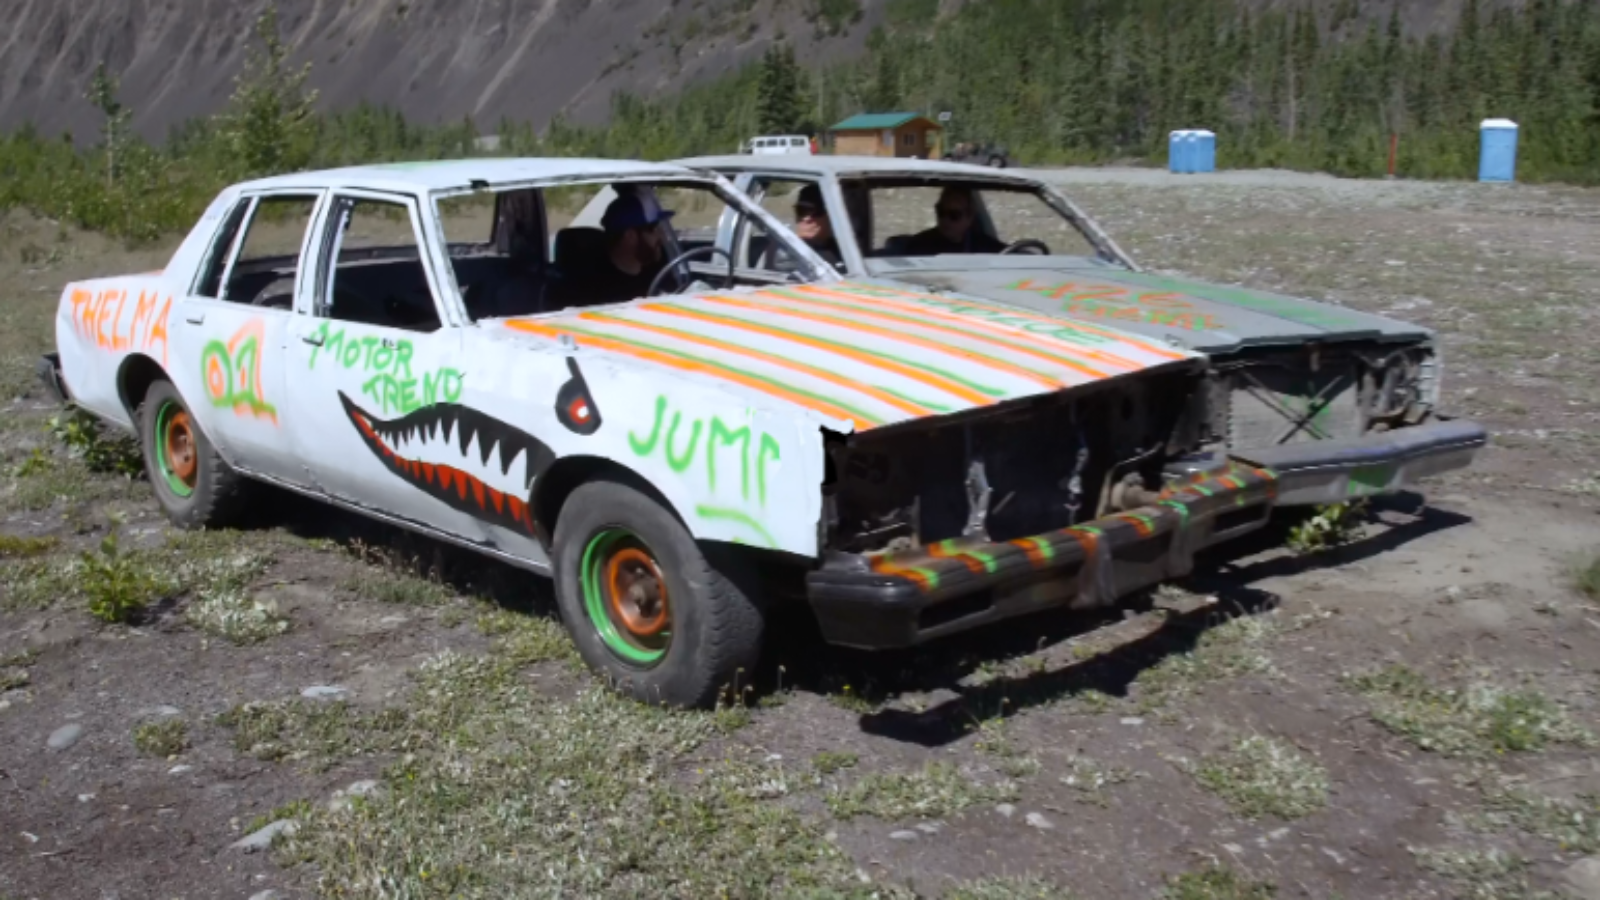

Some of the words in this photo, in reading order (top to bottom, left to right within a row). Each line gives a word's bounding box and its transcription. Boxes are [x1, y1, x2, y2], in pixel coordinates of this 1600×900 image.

[70, 288, 173, 368] THELMA
[307, 319, 414, 379] MOTOR
[361, 366, 463, 415] TREND
